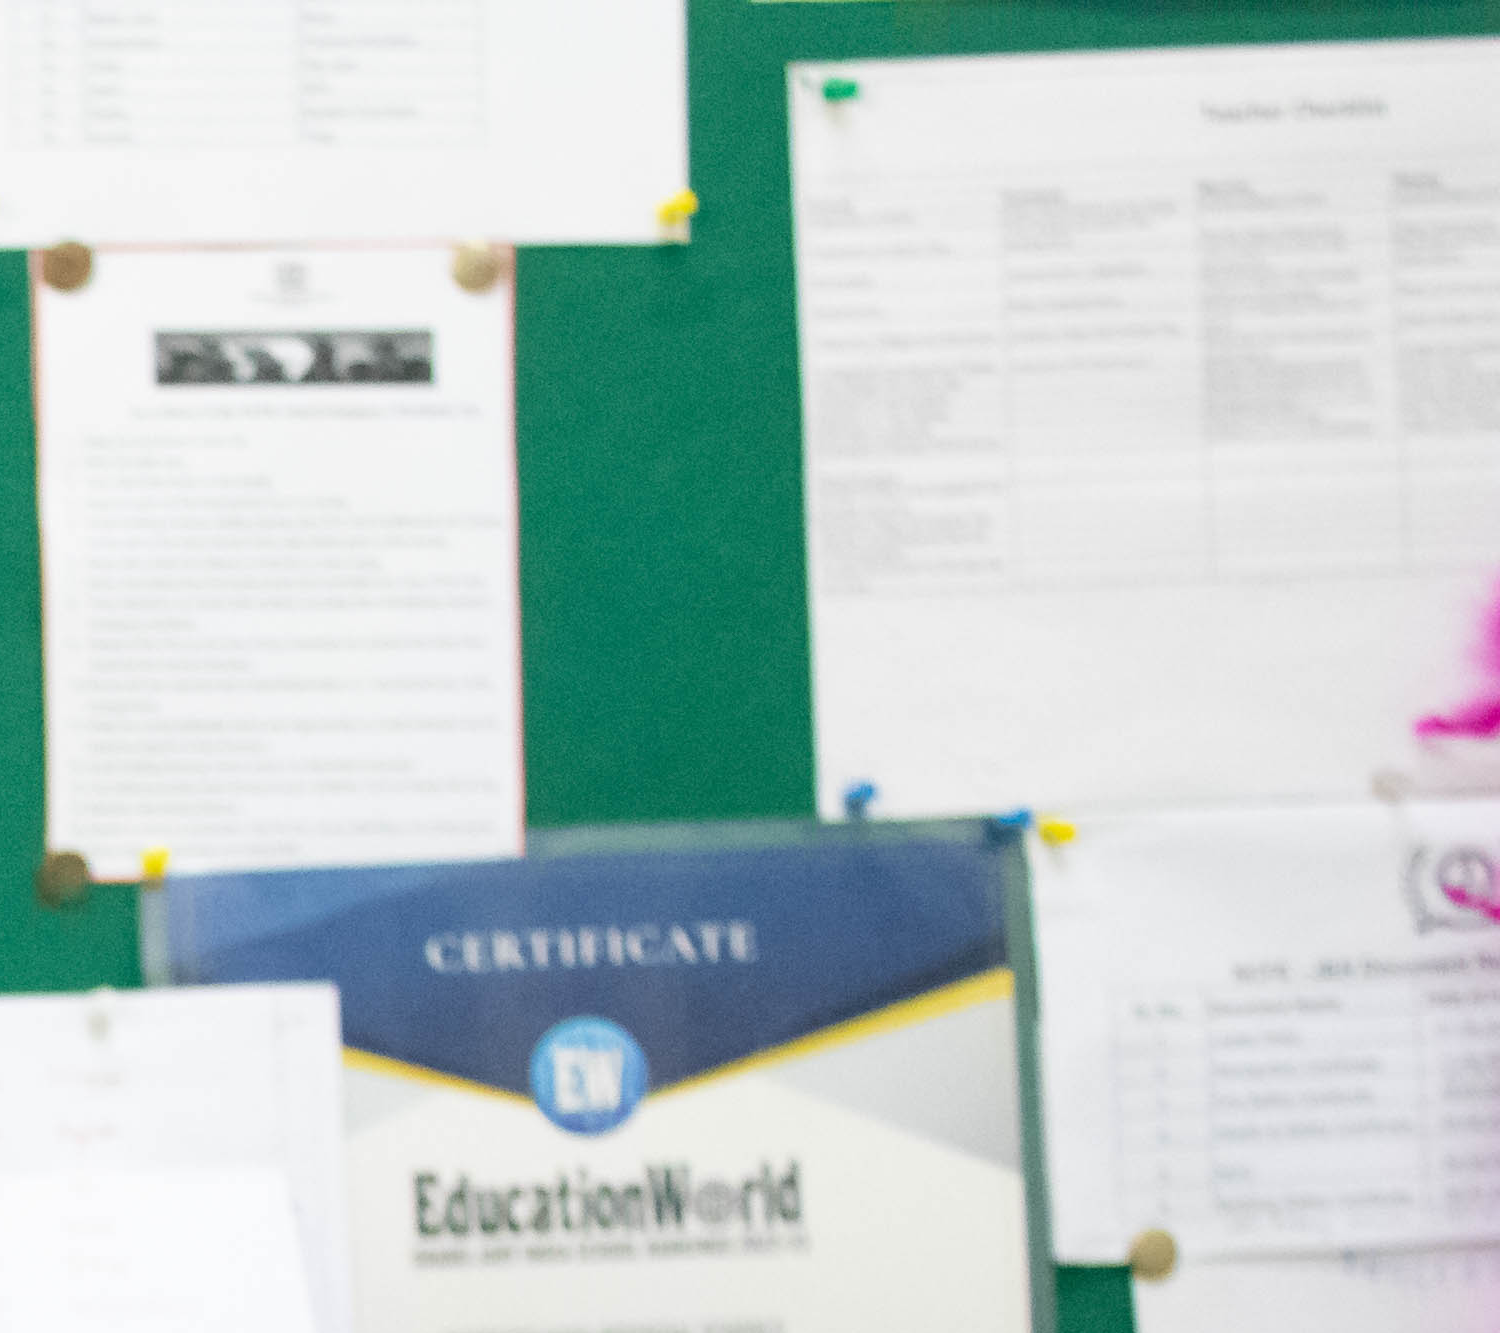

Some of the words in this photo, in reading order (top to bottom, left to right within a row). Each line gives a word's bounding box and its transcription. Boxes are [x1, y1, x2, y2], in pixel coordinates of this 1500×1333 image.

[423, 920, 759, 973] CERTIFICATE
[552, 1047, 623, 1113] EW
[414, 1162, 803, 1236] EducationWorld
